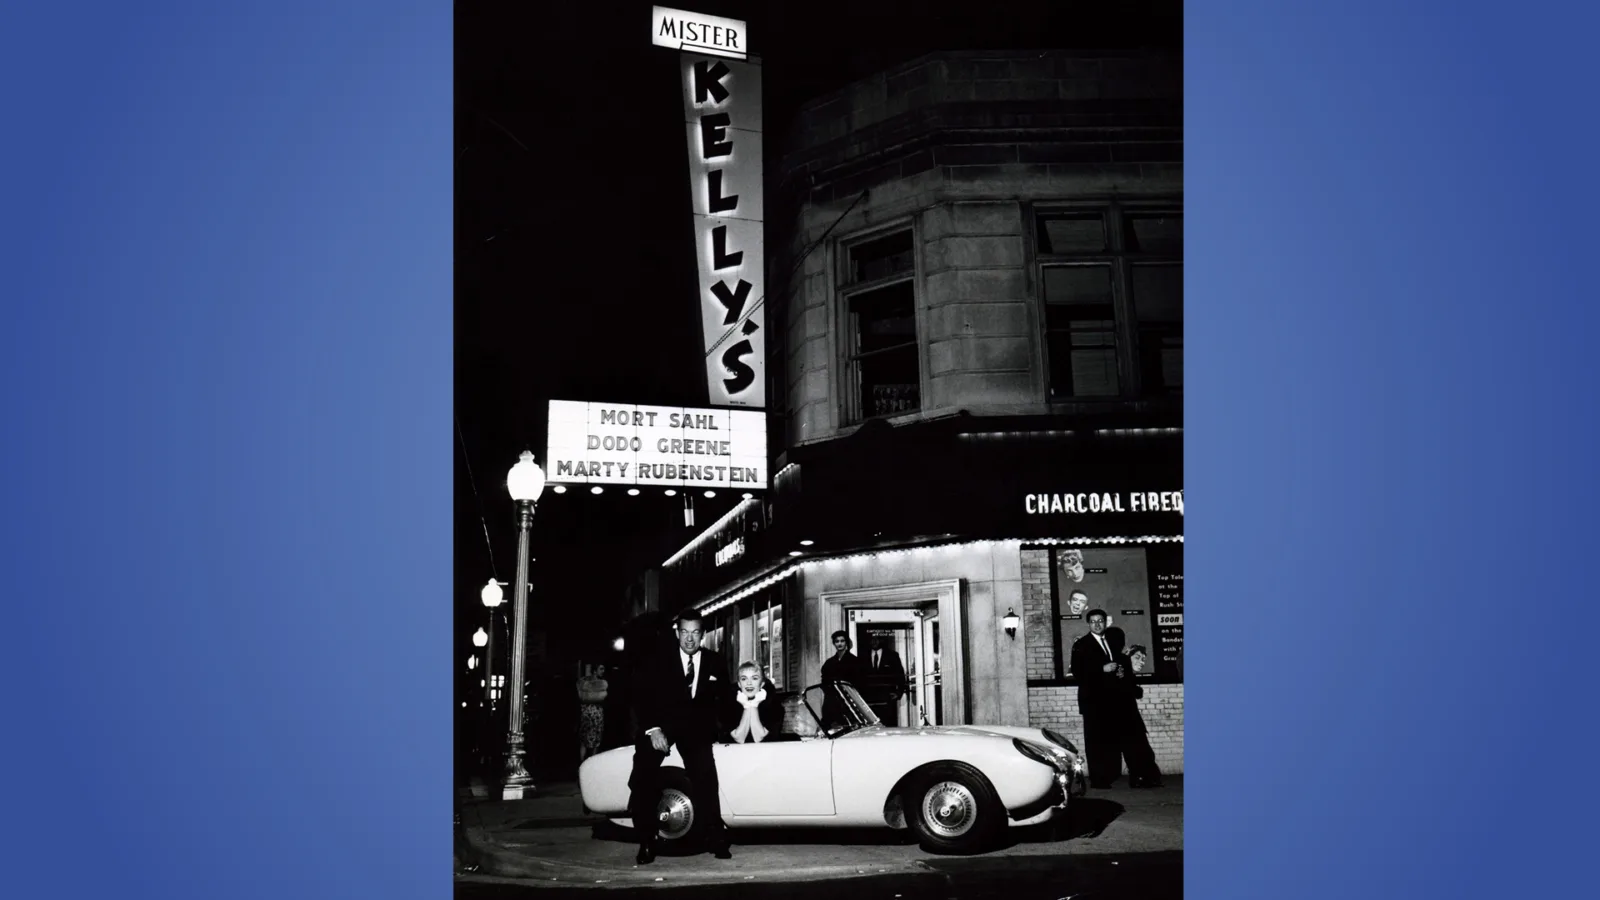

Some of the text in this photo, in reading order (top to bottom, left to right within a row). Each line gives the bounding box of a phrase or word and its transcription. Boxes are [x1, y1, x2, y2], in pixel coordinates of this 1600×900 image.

[659, 16, 739, 48] MISTER
[694, 60, 759, 395] KELLY'S
[601, 409, 718, 430] MORT SAHL
[587, 434, 731, 456] DODO GREENE
[556, 460, 758, 483] MARTY RUBENSTEIN
[1025, 492, 1125, 514] CHARCOAL
